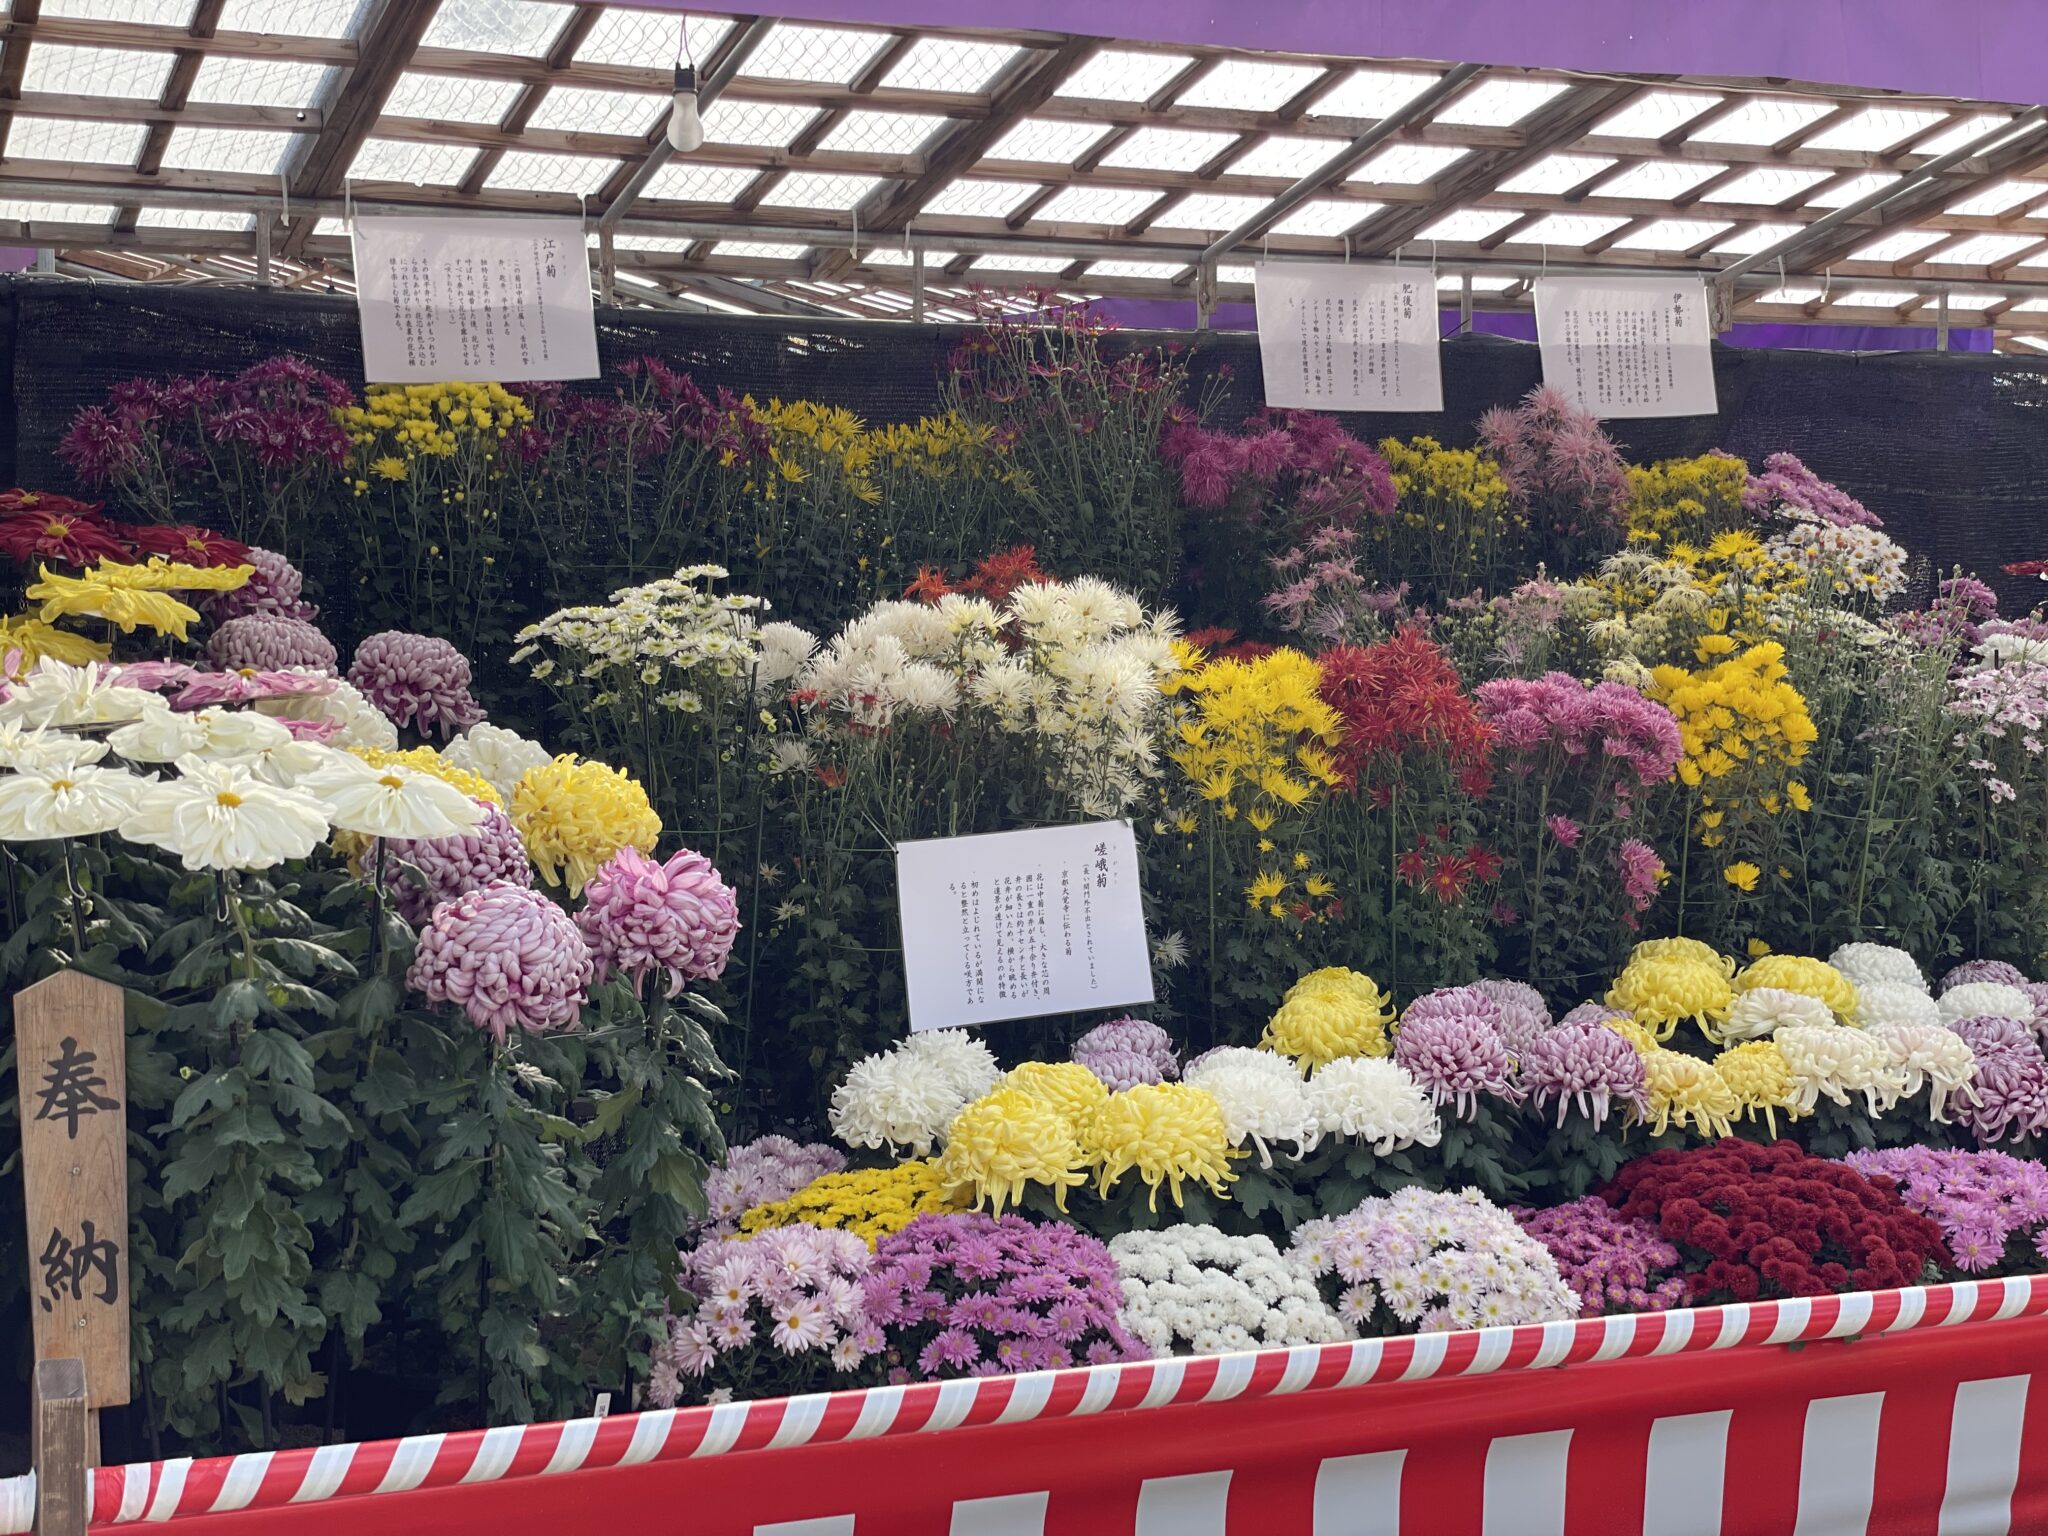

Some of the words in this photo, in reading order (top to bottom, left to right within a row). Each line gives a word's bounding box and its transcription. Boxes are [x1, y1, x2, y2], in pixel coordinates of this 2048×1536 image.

[543, 238, 557, 279] 江戸菊
[1402, 283, 1413, 320] 肥後菊
[1673, 292, 1683, 328] 伊勢菊
[949, 882, 957, 895] る。
[1094, 842, 1108, 888] 嵯峨菊
[960, 881, 974, 1005] ると整然と立ってくる咲方であ
[970, 880, 984, 1004] 初めはよじれているが満開にな
[993, 878, 1007, 999] と遠景が透けて見えるのが特徴
[1004, 876, 1018, 1000] 花弁が細いため、横から眺める
[1014, 875, 1030, 998] 弁の長さは約十センチと長いが
[34, 1036, 121, 1313] 奉納
